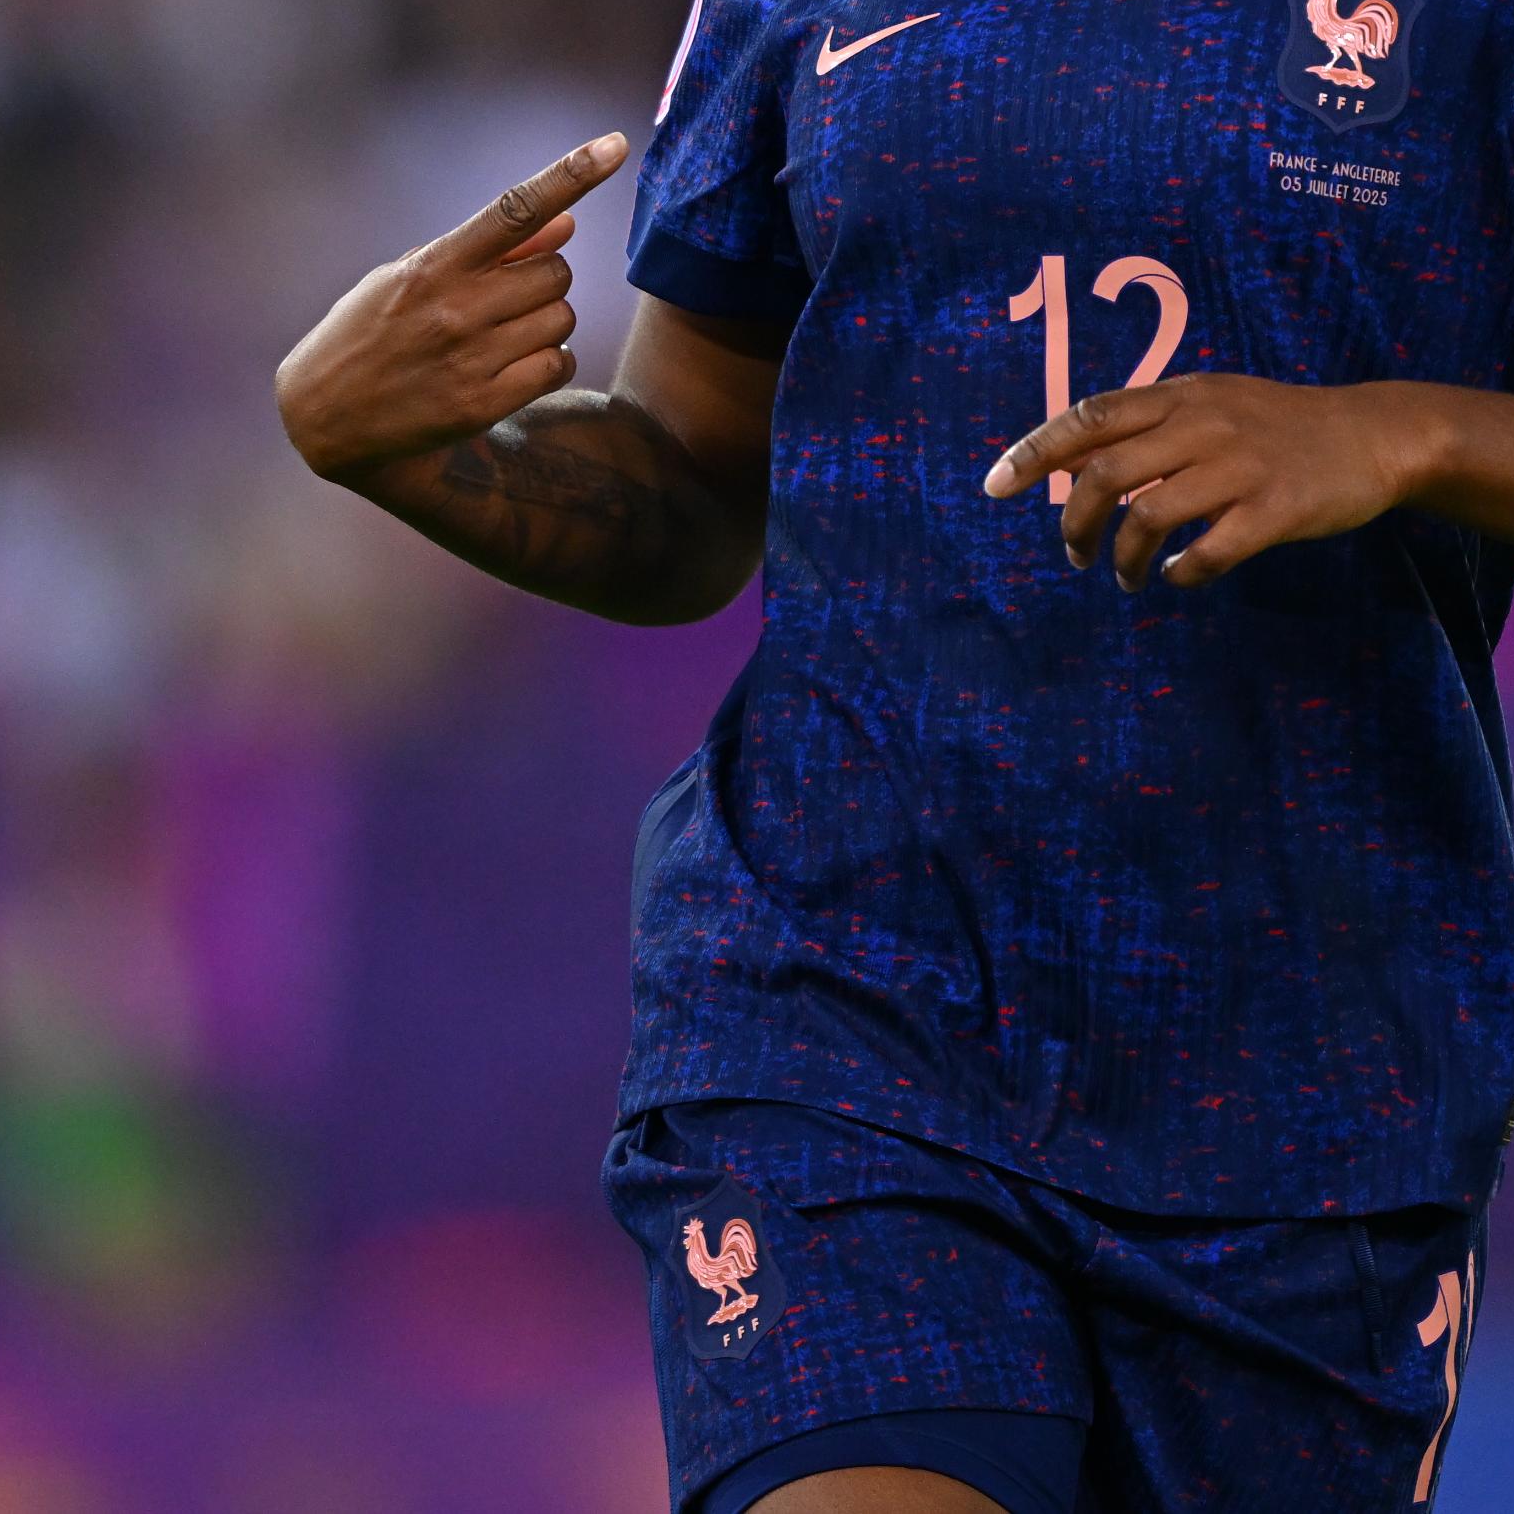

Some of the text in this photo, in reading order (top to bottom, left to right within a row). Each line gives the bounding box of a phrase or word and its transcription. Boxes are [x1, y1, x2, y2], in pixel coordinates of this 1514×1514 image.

[1269, 151, 1318, 173] FRANCE
[1331, 161, 1402, 187] ANGLETERRE
[1280, 175, 1388, 207] 05 JUILLET 2025
[1009, 255, 1189, 505] 12
[1413, 1249, 1475, 1503] 1
